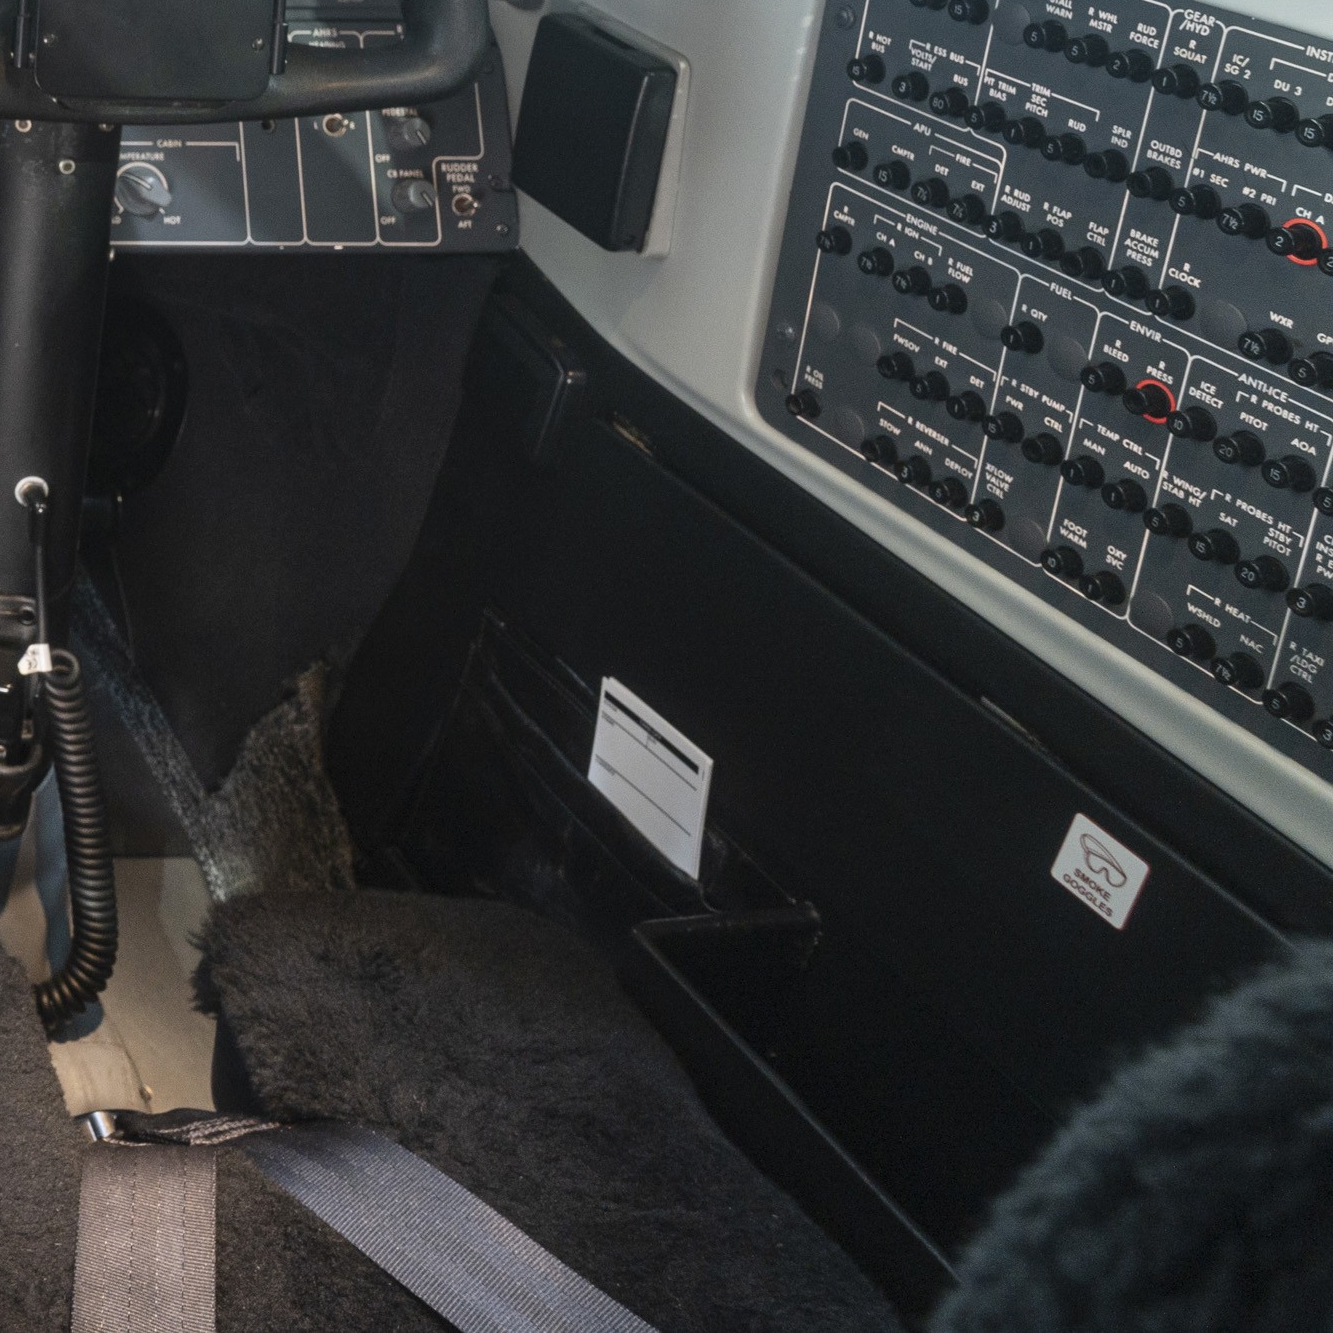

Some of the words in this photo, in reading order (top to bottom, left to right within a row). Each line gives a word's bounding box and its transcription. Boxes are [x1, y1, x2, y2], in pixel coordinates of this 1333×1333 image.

[1046, 4, 1073, 19] WARN
[1183, 8, 1216, 27] GEAR
[1179, 19, 1211, 37] /HYD
[1129, 32, 1160, 48] FORCE
[1173, 45, 1207, 64] SQUAT
[1025, 103, 1048, 117] PITCH
[156, 139, 182, 148] CABIN
[1150, 139, 1183, 158] OUTBD
[441, 163, 478, 173] RUDDER
[1146, 149, 1182, 170] BRAKES
[1213, 152, 1241, 169] AHRS
[1243, 162, 1268, 179] PWR
[446, 173, 474, 183] PEDAL
[906, 214, 938, 235] ENGINE
[1168, 267, 1201, 289] CLOCK
[1050, 283, 1073, 300] FUEL
[1129, 320, 1162, 342] ENVIR
[1103, 345, 1129, 363] BLEED
[1189, 386, 1223, 409] DETECT
[1240, 411, 1269, 431] PITOT
[1097, 424, 1120, 442] TEMP
[1123, 438, 1143, 455] CTRL
[1123, 461, 1150, 479] AUTO
[1063, 518, 1088, 536] FOOT
[1059, 526, 1087, 549] WARM
[1187, 602, 1221, 629] WSHLD
[1225, 602, 1252, 624] HEAT
[1074, 868, 1111, 901] SMOKE
[1063, 874, 1113, 917] GOGGLES
